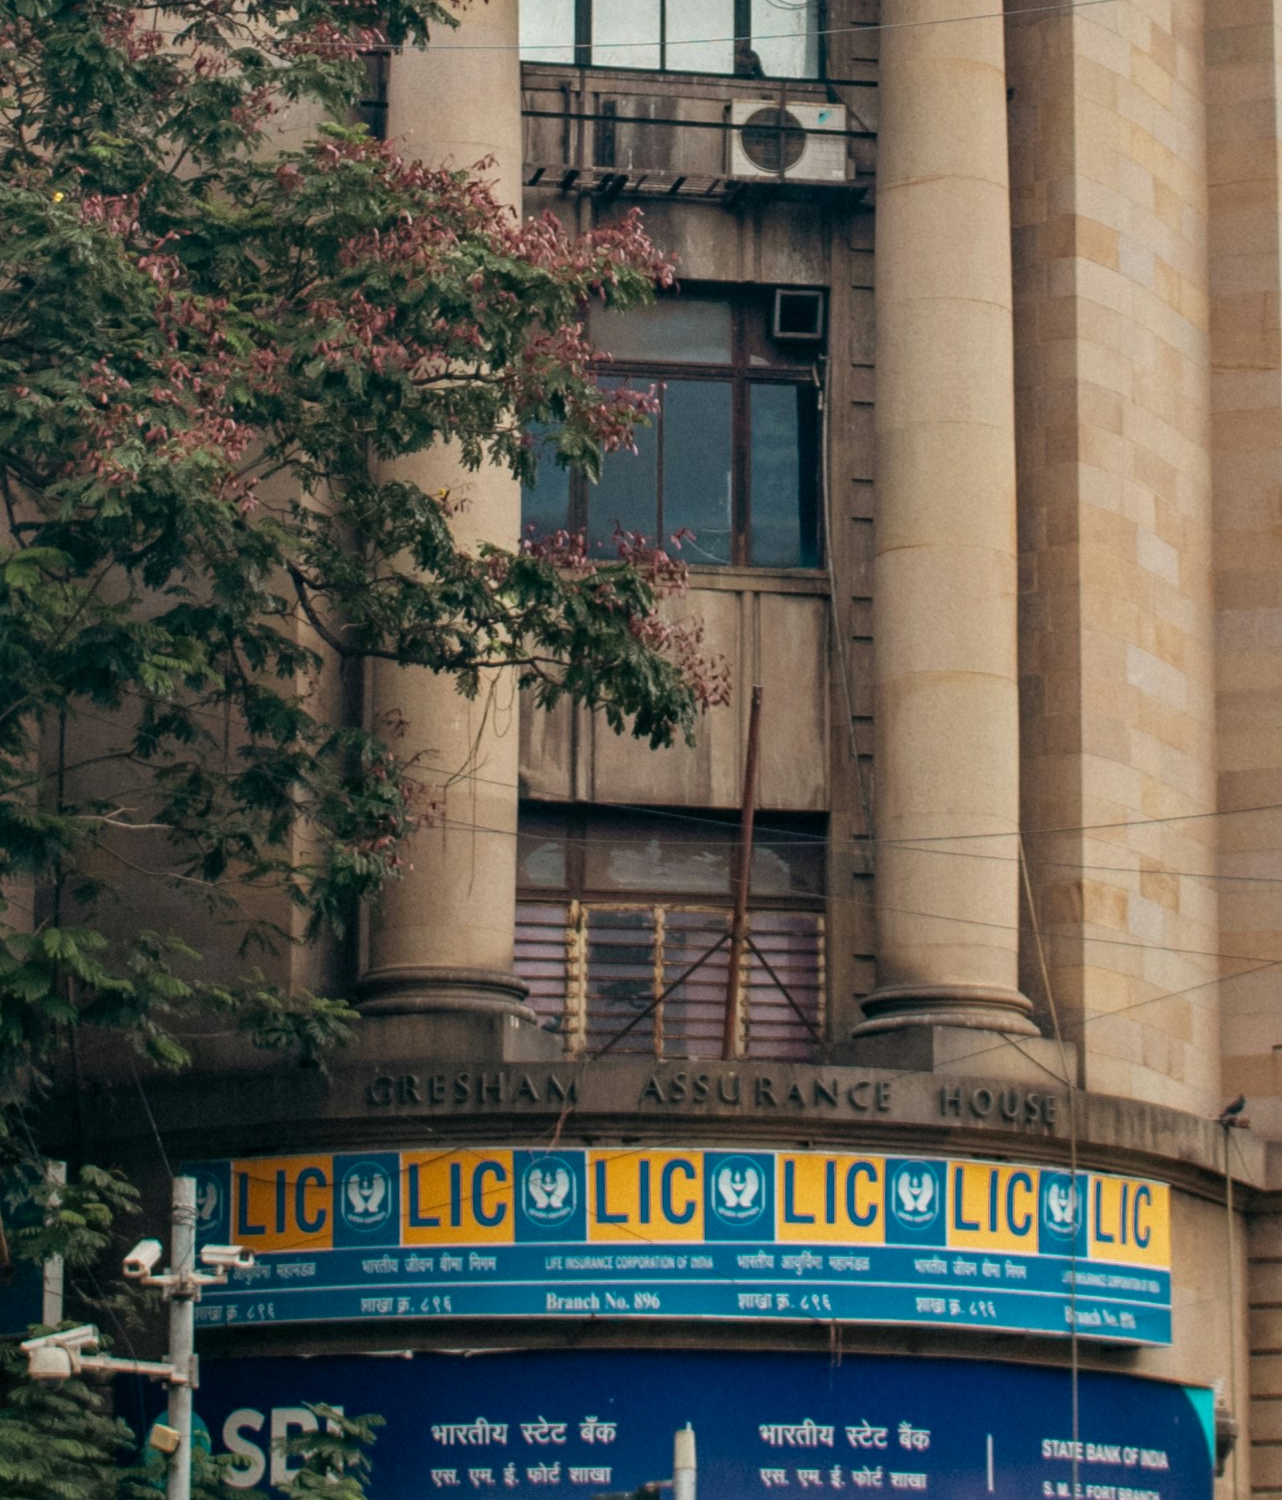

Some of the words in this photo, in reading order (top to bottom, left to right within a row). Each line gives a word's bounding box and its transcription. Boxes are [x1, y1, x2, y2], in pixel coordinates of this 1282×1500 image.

[368, 1070, 580, 1106] GRESHAM
[639, 1071, 892, 1113] ASSURANCE
[940, 1085, 1058, 1130] HOUSE
[236, 1165, 327, 1237] LIC
[407, 1160, 508, 1229] LIC
[594, 1157, 697, 1225] LIC
[782, 1159, 879, 1228] LIC
[953, 1165, 1034, 1237] LIC
[1093, 1178, 1152, 1249] LIC
[362, 1253, 399, 1274] भारतीय
[405, 1252, 434, 1273] जीवन
[545, 1255, 563, 1270] LIFE
[565, 1255, 614, 1270] INSURANCE
[615, 1254, 675, 1270] CORPORATION
[676, 1255, 688, 1269] OF
[737, 1249, 774, 1270] भारतीय
[246, 1303, 275, 1321] ८९६
[360, 1297, 393, 1314] शाखा
[420, 1295, 452, 1313] ८९६
[545, 1291, 600, 1310] Branch
[605, 1291, 630, 1310] No.
[634, 1291, 661, 1310] 896
[737, 1293, 773, 1310] शाखा
[800, 1293, 832, 1312] ८९६
[969, 1300, 997, 1319] ८९६
[430, 1417, 509, 1446] भारतीय
[519, 1415, 567, 1445] स्टेट
[758, 1417, 835, 1447] भारतीय
[844, 1418, 889, 1448] स्टेट
[1042, 1438, 1084, 1461] STATE
[1086, 1442, 1122, 1464] BANK
[1122, 1446, 1139, 1466] OF
[1140, 1447, 1170, 1471] INDIA
[430, 1468, 461, 1488] एस.
[468, 1468, 496, 1488] एम.
[503, 1462, 520, 1488] ई.
[526, 1461, 561, 1484] फोर्ट
[568, 1467, 613, 1484] शाखा
[759, 1467, 790, 1488] एस.
[796, 1468, 824, 1488] एम.
[829, 1464, 846, 1489] ई.
[851, 1465, 884, 1488] फोर्ट
[889, 1471, 928, 1489] शाखा
[1042, 1480, 1056, 1498] S.
[1086, 1483, 1117, 1500] FORT
